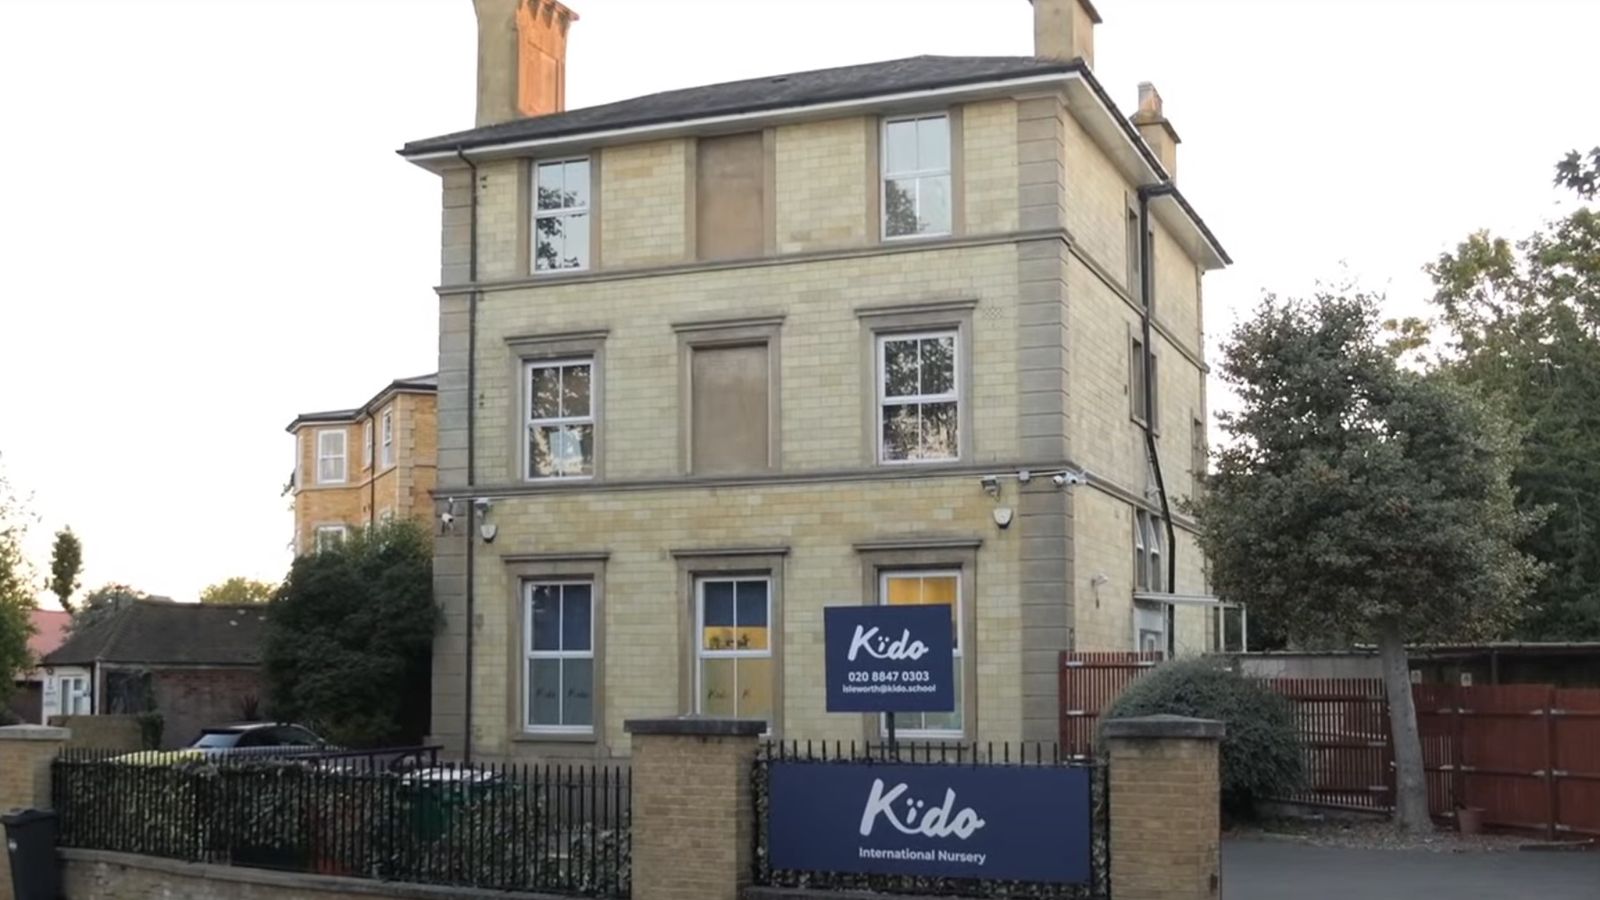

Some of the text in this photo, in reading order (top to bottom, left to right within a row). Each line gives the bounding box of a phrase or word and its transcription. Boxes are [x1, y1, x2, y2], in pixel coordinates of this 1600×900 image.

[848, 670, 930, 682] 020 8847 0303
[858, 847, 986, 865] International Nursery
